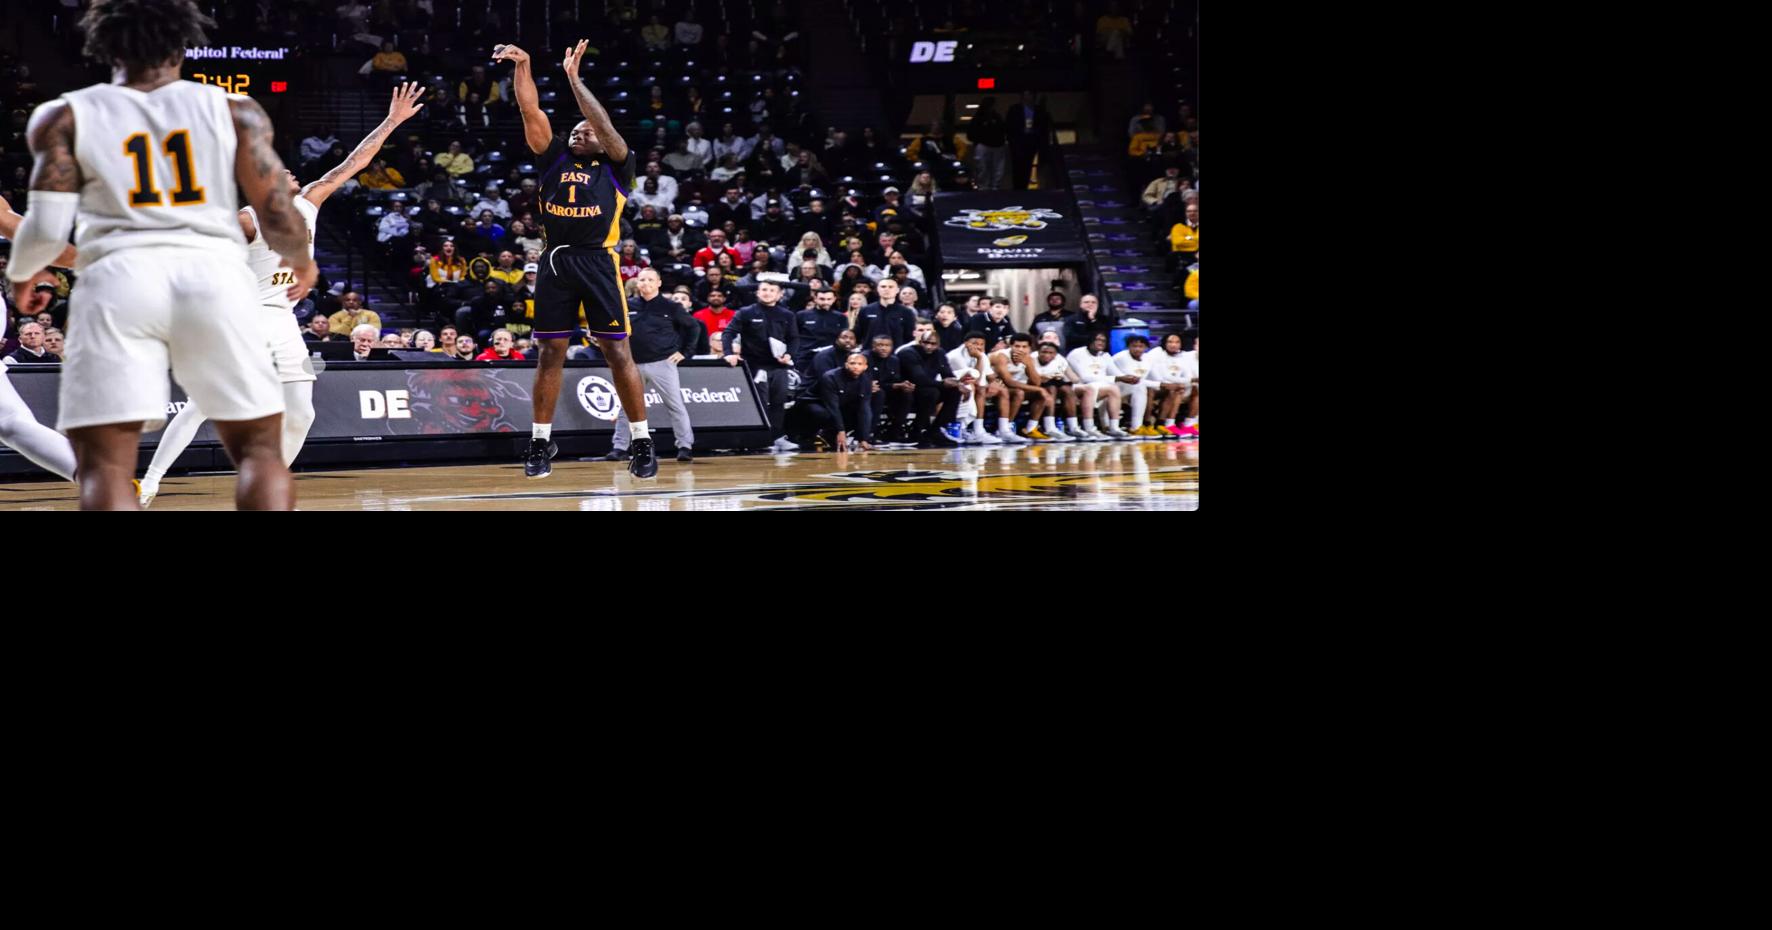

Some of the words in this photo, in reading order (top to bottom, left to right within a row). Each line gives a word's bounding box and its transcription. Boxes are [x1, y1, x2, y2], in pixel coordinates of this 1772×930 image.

[184, 47, 227, 60] apitol
[909, 41, 958, 63] DE
[123, 129, 206, 207] 11
[560, 171, 591, 185] EAST
[568, 184, 577, 203] 1
[545, 201, 602, 218] CAROLINA
[271, 271, 295, 286] STA
[358, 389, 412, 419] DE
